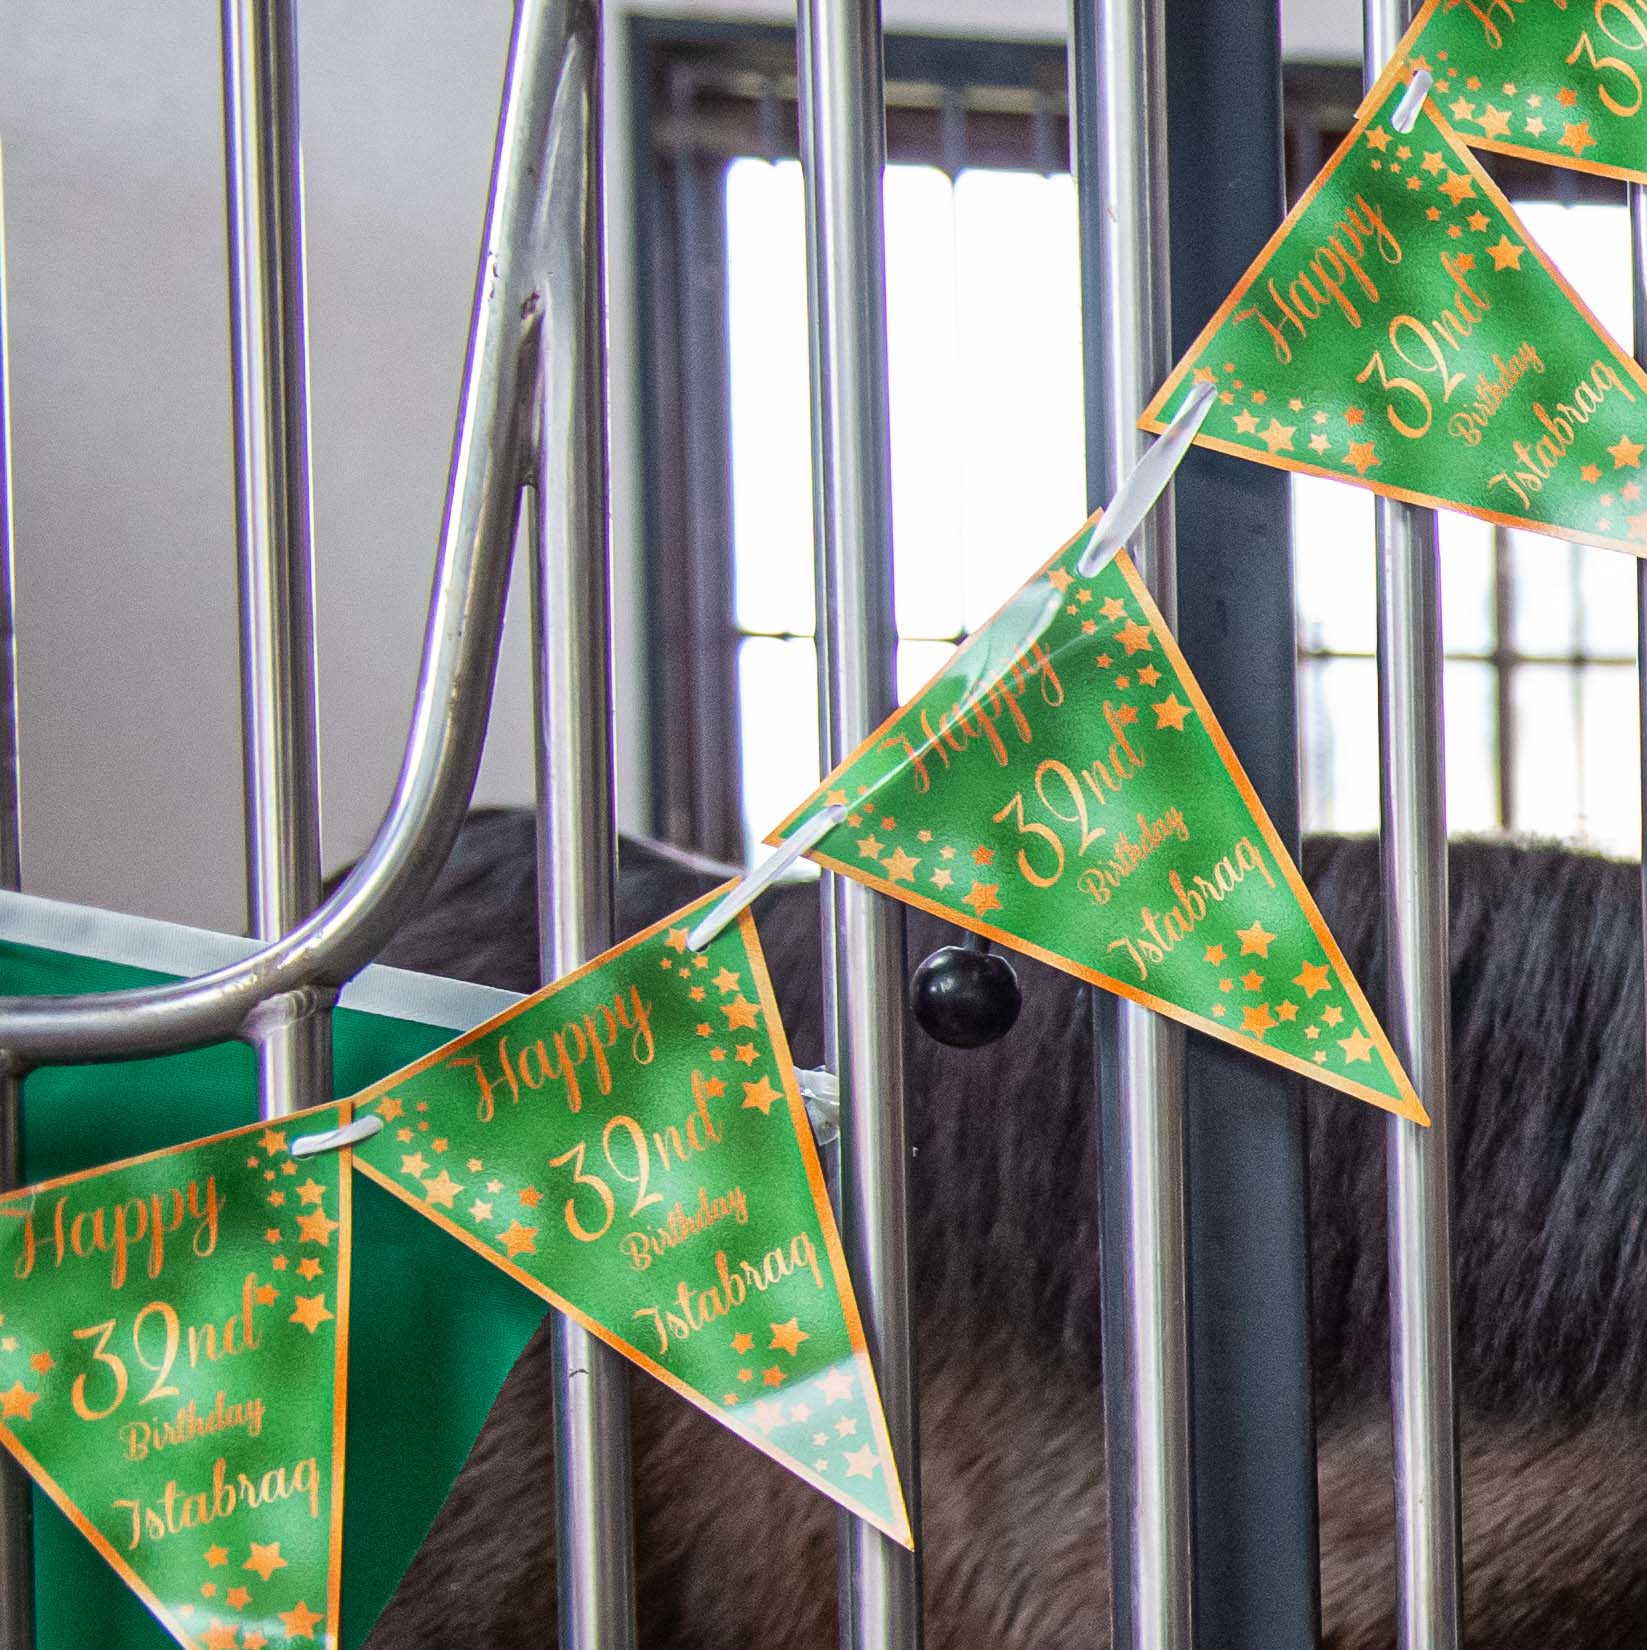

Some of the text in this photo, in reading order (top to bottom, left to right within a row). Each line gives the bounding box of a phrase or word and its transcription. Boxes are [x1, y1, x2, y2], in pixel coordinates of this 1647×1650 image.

[1232, 194, 1402, 365] Happy
[1355, 252, 1491, 439] 32nd
[1449, 342, 1545, 447] Birthday
[1488, 359, 1636, 510] Istabraq
[878, 633, 1064, 793] Happy
[993, 701, 1147, 889] 32nd
[1078, 806, 1190, 905] Birthday
[1107, 836, 1275, 981] Istabraq
[446, 984, 655, 1122] Happy
[549, 1069, 724, 1242] 32nd
[0, 1176, 225, 1289] Happy
[620, 1185, 749, 1271] Birthday
[632, 1231, 824, 1355] Istabraq
[71, 1272, 262, 1421] 32nd
[120, 1391, 265, 1461] Birthday
[113, 1457, 320, 1551] Istabraq
